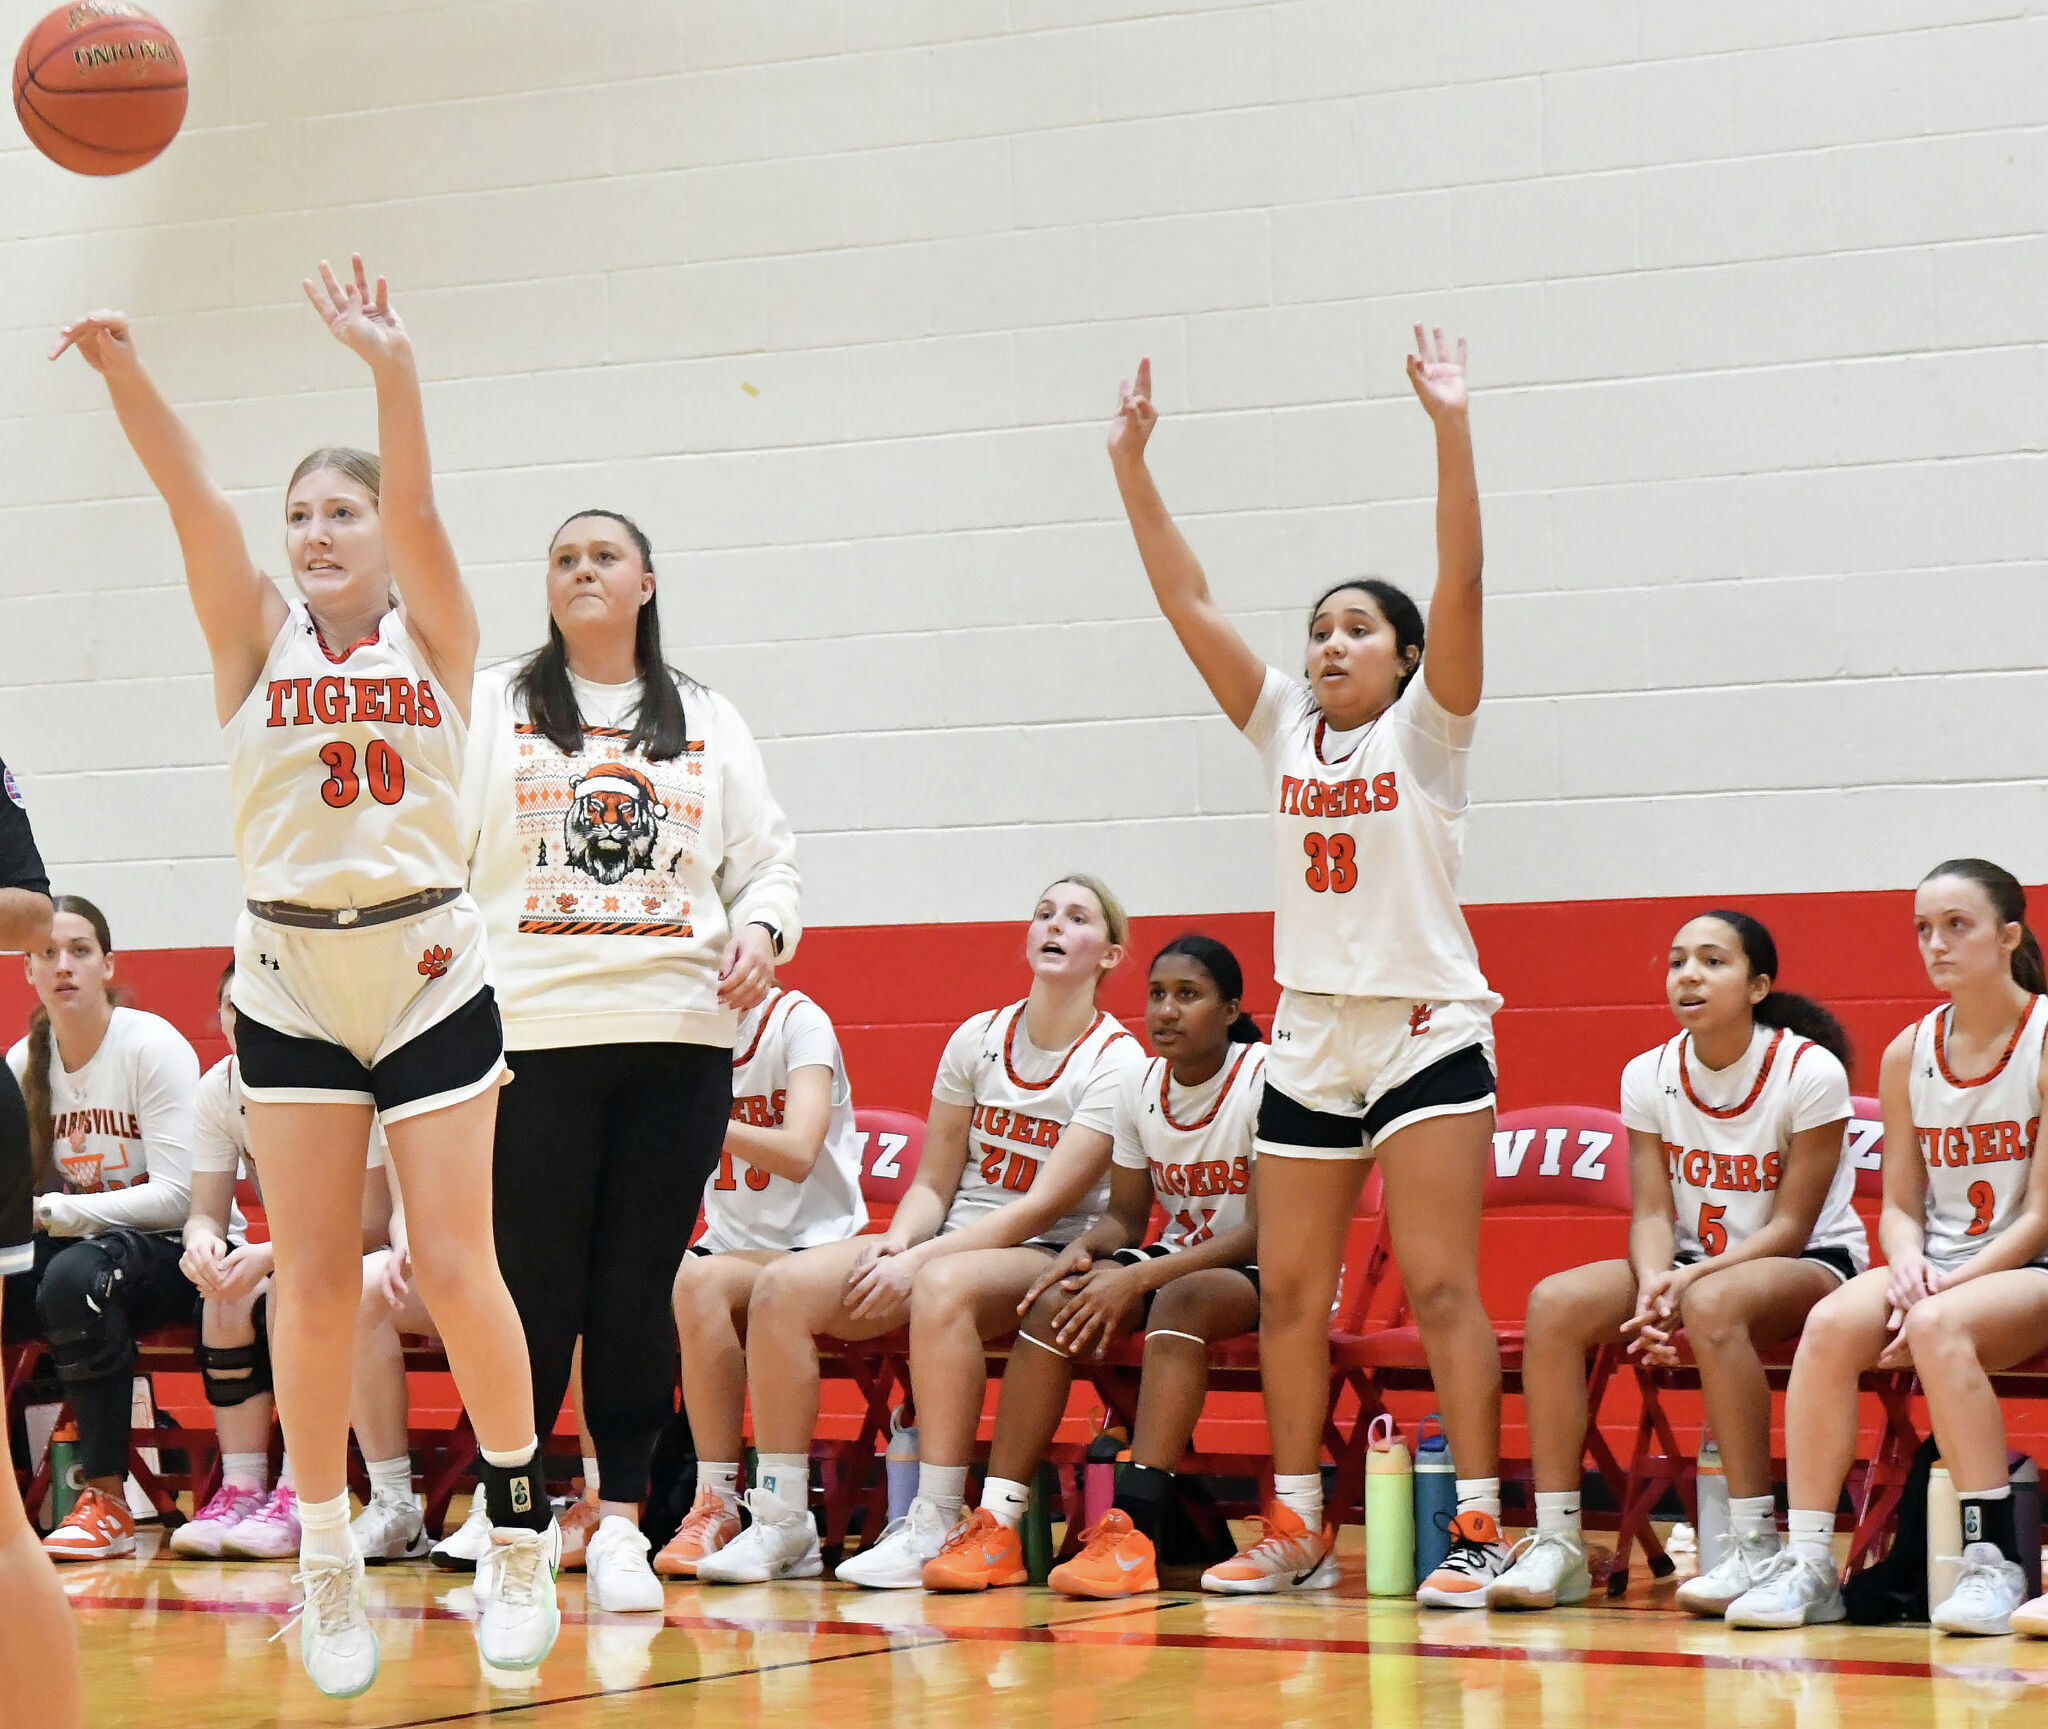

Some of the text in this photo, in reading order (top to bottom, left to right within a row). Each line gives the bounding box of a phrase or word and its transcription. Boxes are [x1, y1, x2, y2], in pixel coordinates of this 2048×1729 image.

[266, 676, 442, 728] TIGERS
[319, 739, 405, 808] 30
[1280, 771, 1399, 818] TIGERS
[1304, 832, 1358, 893] 33
[973, 1104, 1062, 1150] IGER
[980, 1142, 1038, 1193] 20
[1491, 1127, 1614, 1181] VIZ
[1698, 1202, 1727, 1257] 5
